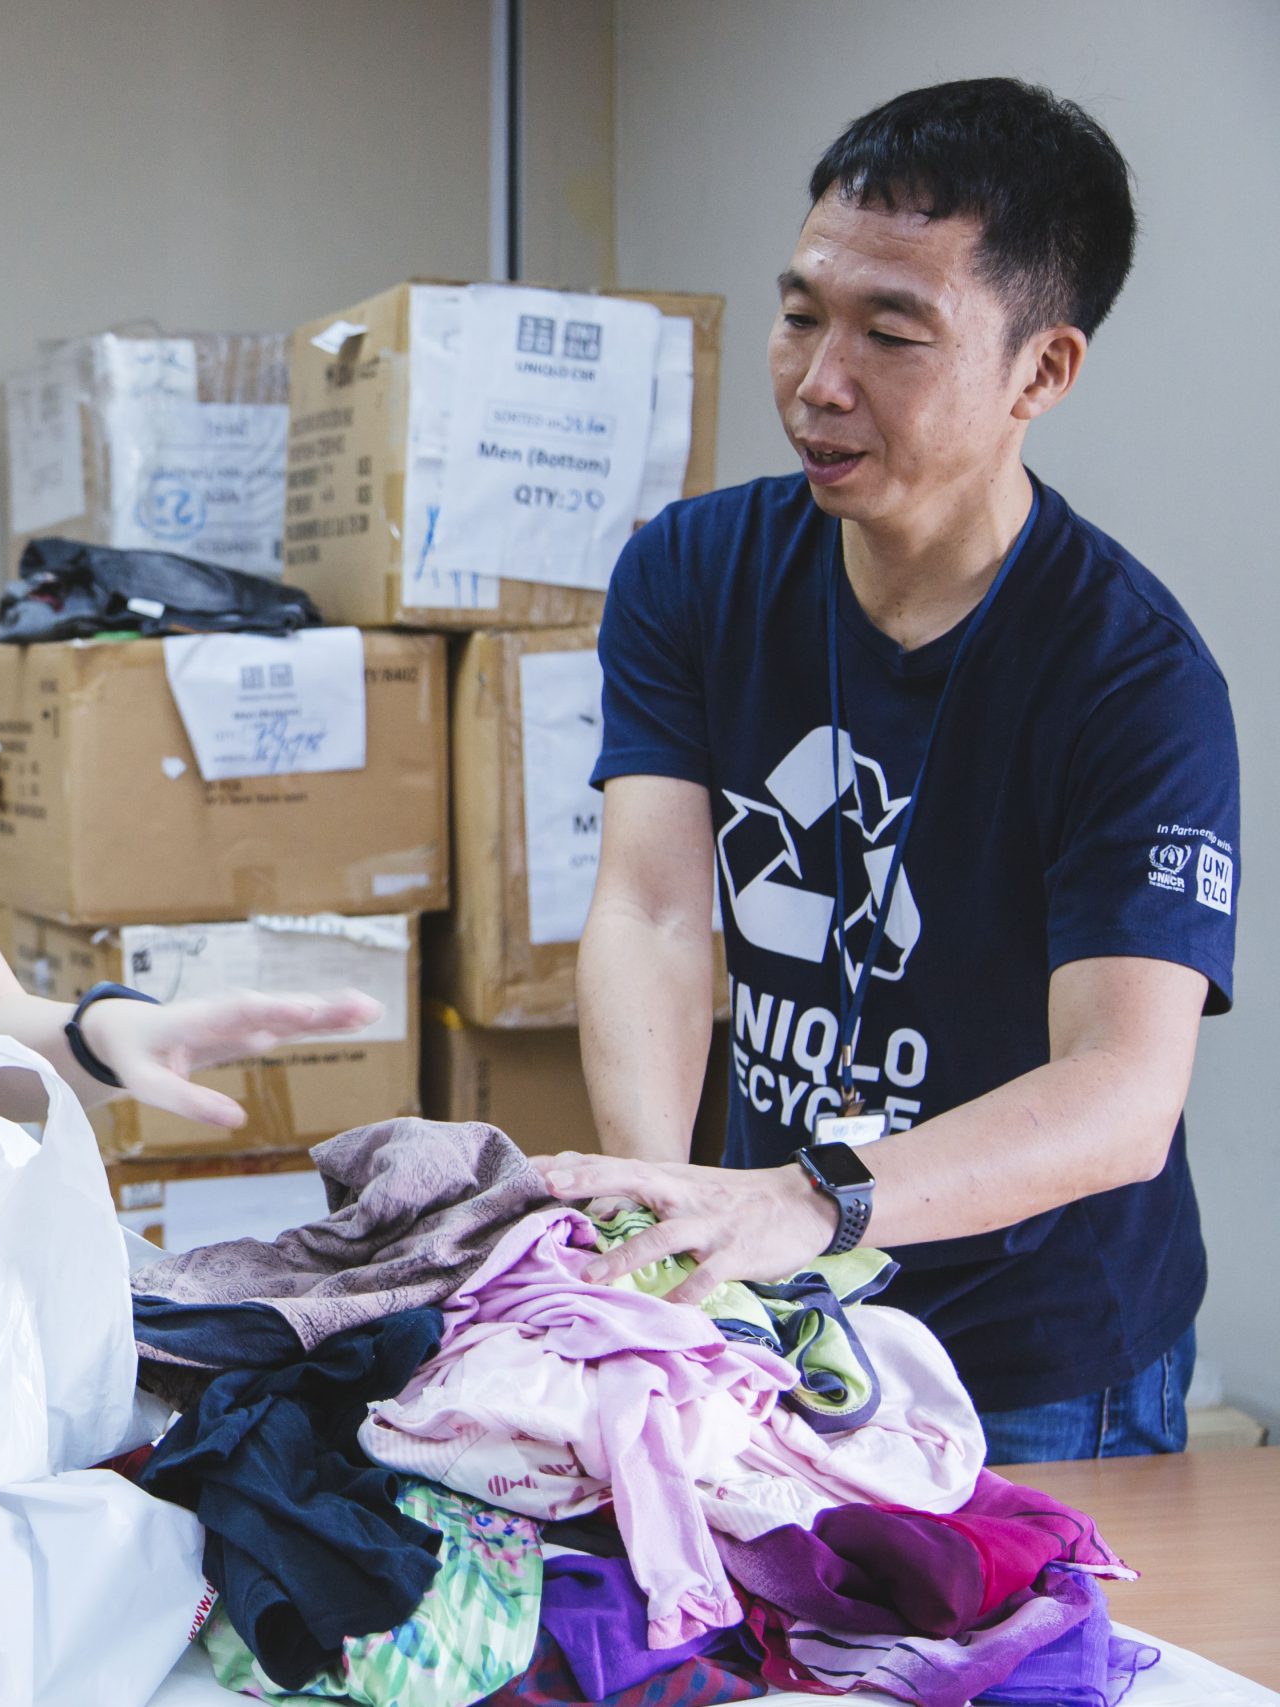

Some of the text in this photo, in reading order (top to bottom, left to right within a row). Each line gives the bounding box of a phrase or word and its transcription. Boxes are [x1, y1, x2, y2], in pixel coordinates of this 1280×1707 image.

[478, 441, 611, 479] Men (Bottom)
[1157, 823, 1169, 834] In
[1203, 854, 1229, 884] UNI
[1203, 878, 1227, 905] QLO
[729, 972, 928, 1088] NIQLO
